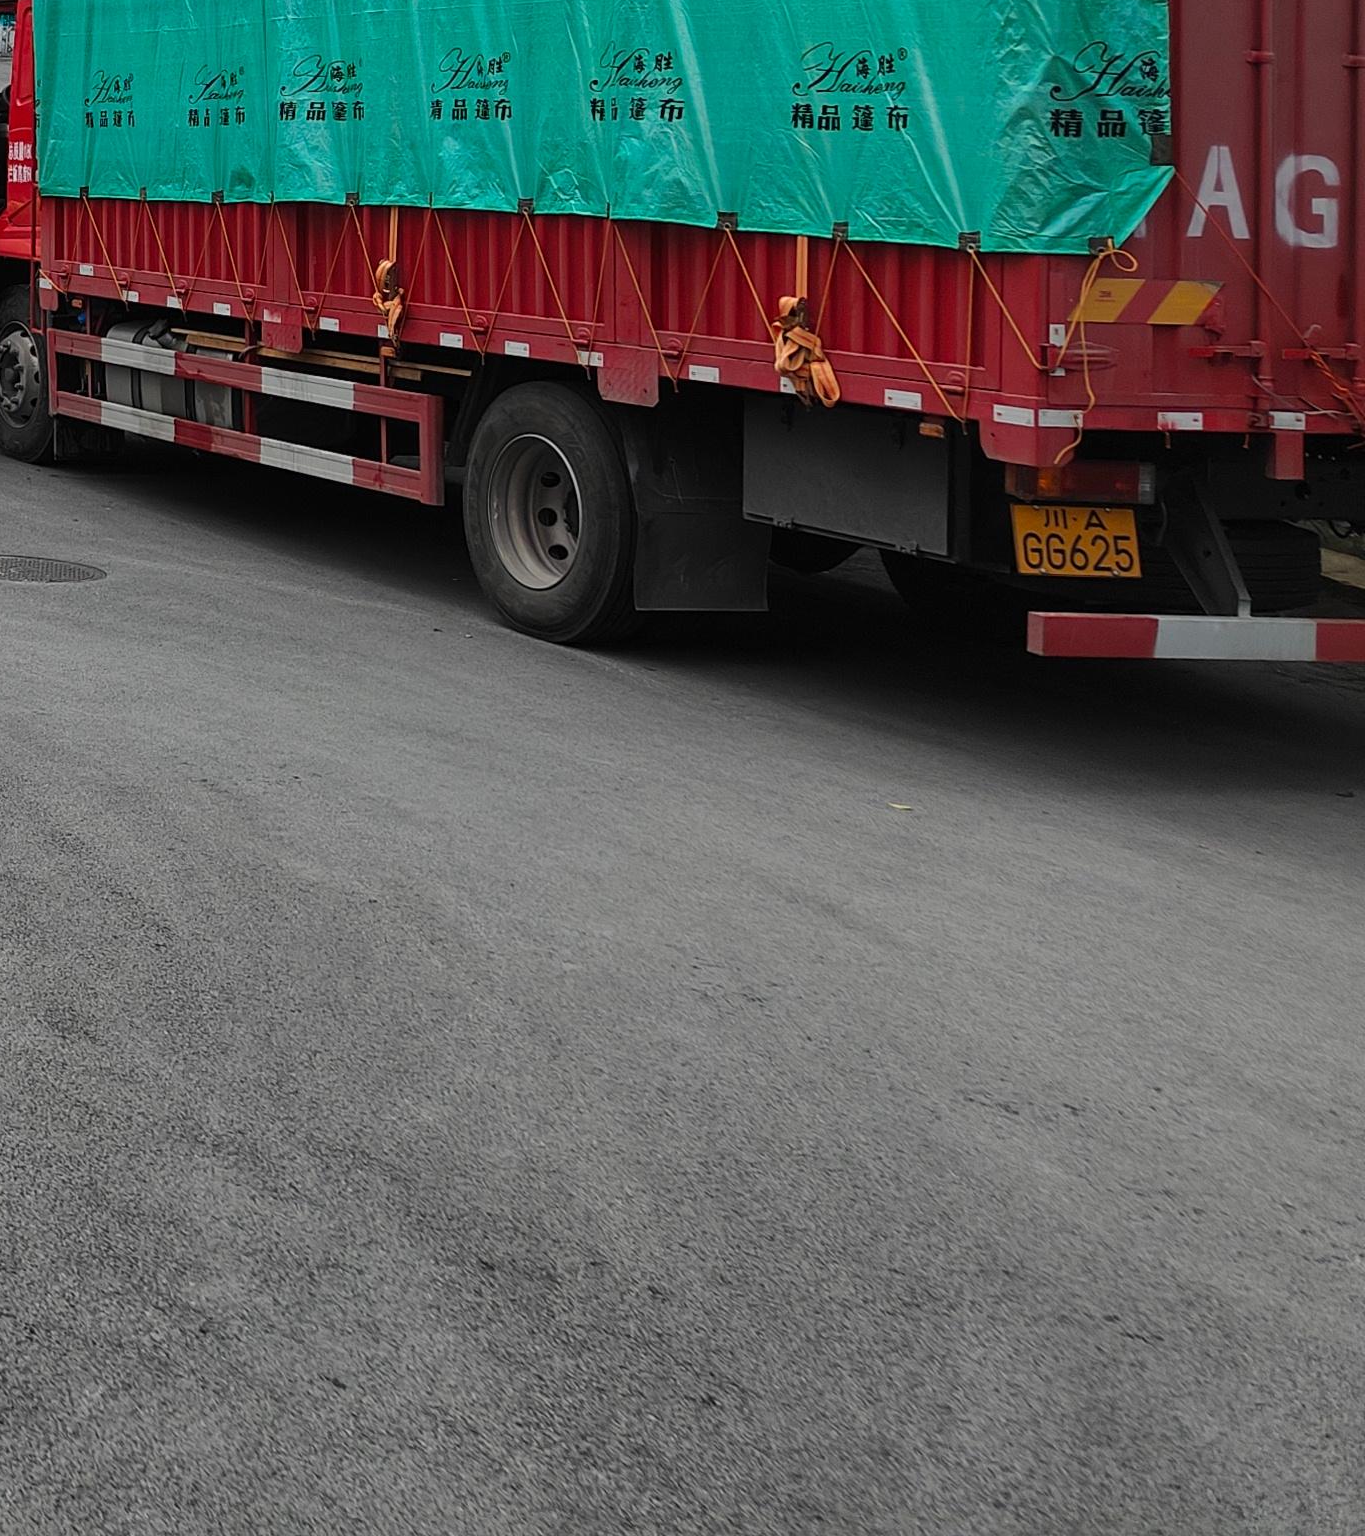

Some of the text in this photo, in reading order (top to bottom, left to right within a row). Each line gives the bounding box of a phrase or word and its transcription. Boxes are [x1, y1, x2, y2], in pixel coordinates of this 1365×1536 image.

[790, 103, 910, 132] 精品篷布
[1133, 145, 1341, 249] AG
[1022, 531, 1134, 572] GG625
